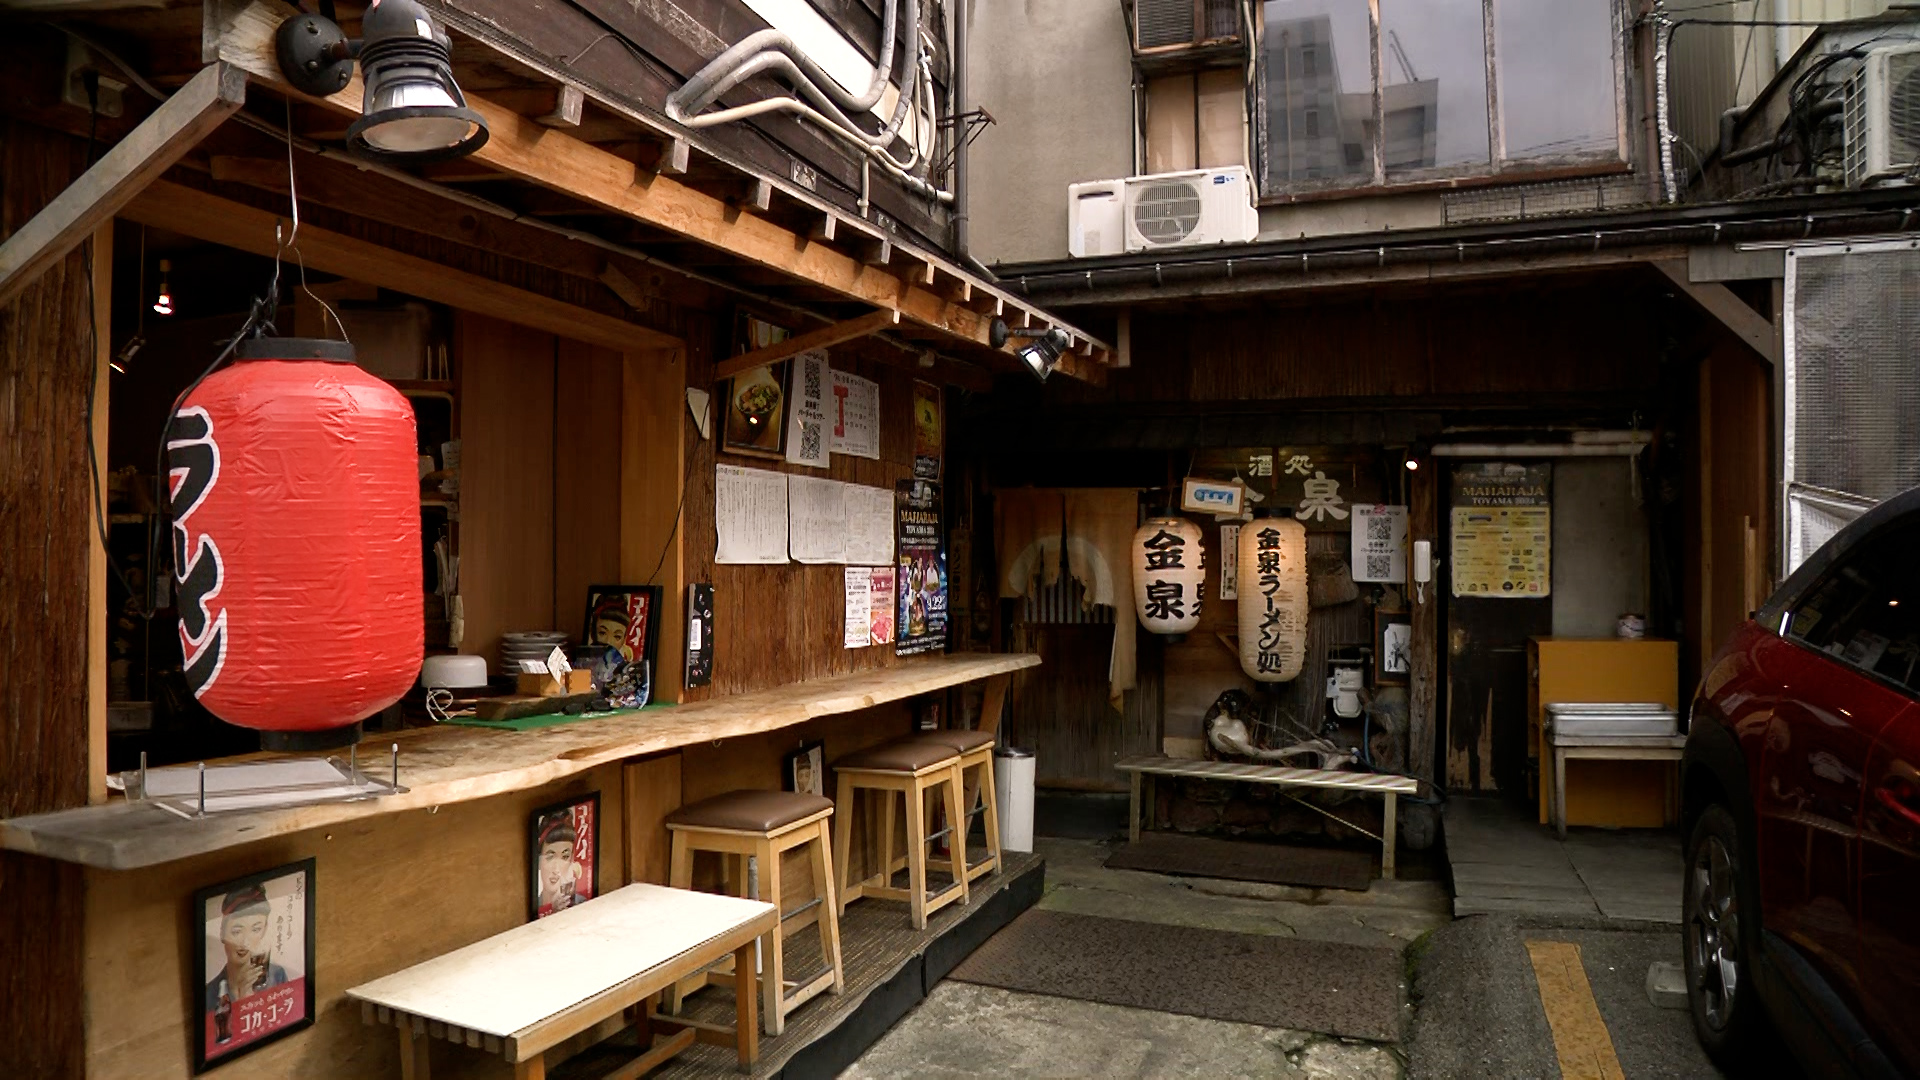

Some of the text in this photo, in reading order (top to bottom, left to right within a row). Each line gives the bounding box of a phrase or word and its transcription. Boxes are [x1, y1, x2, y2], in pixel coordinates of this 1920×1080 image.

[1248, 454, 1314, 478] 酒処
[1462, 486, 1545, 497] MAHARAJA
[1471, 497, 1513, 505] TOYAMA
[1143, 527, 1186, 620] 金泉
[1256, 526, 1282, 674] 金泉ラーメン処
